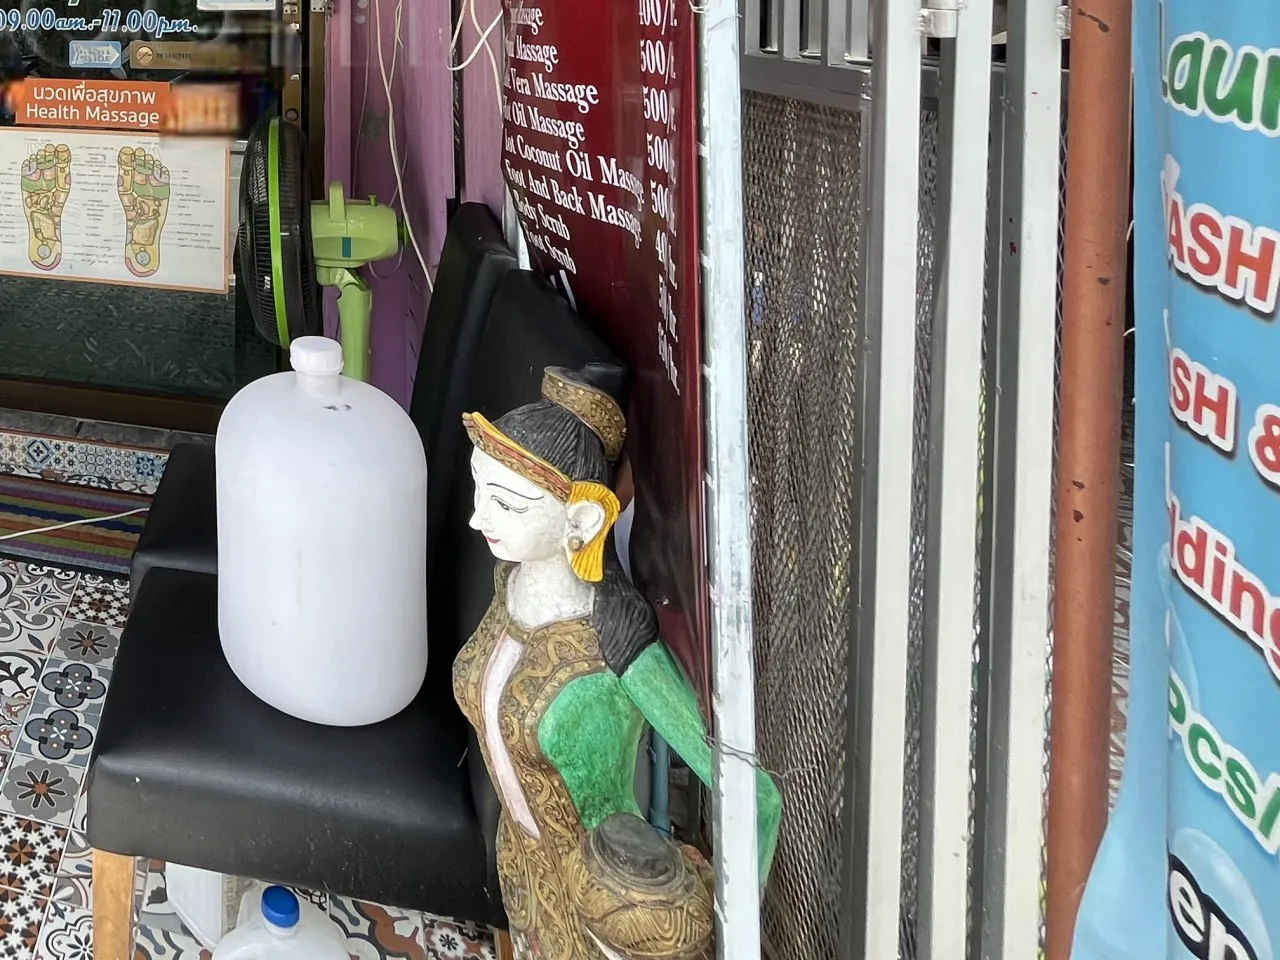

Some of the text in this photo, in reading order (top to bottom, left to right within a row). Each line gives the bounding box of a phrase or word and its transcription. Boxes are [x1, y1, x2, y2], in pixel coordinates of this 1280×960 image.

[516, 35, 559, 73] Massage
[33, 81, 156, 106] นวดเพื่อสุขภาพ
[510, 67, 531, 96] Vera
[531, 72, 599, 114] Massage
[25, 102, 160, 126] Health Massage
[512, 101, 527, 128] Oil
[527, 105, 585, 149] Massage
[516, 135, 563, 173] Coconut
[566, 149, 594, 181] Oil
[528, 169, 551, 201] And
[550, 178, 586, 216] Back
[587, 191, 643, 250] Massage
[537, 203, 570, 241] Scrub
[545, 235, 577, 275] Scrub
[1162, 170, 1278, 308] ASH
[1167, 348, 1232, 448] SH
